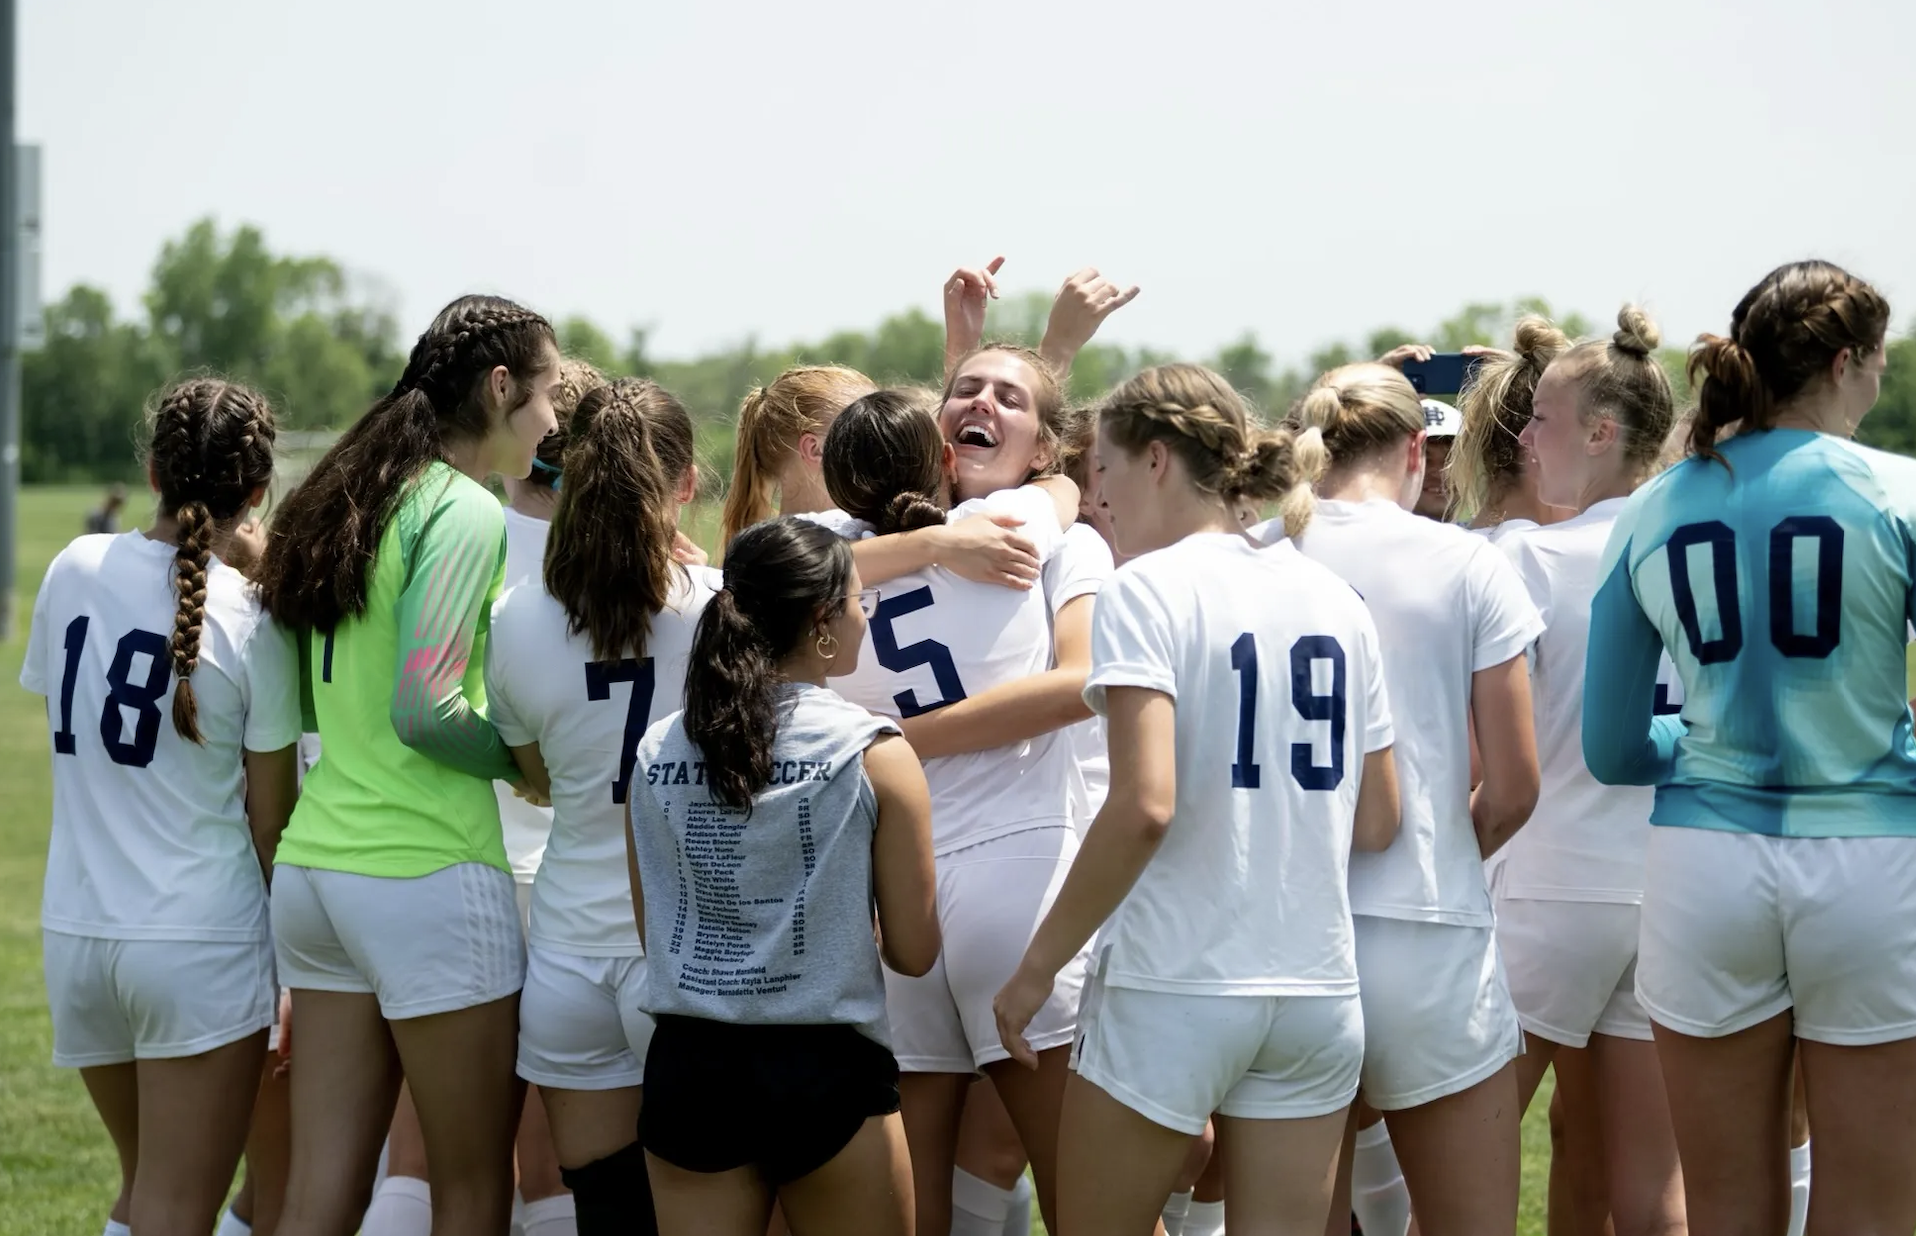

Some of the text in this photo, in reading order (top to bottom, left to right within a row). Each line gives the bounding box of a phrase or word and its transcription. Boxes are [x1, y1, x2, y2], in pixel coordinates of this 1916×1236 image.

[1667, 515, 1845, 667] 00
[868, 584, 968, 719] 5
[54, 615, 173, 769] 18
[1230, 632, 1346, 791] 19
[584, 656, 656, 804] 7
[646, 761, 833, 787] STAT CCER
[687, 816, 708, 824] Abby
[685, 830, 718, 838] Addison
[684, 845, 713, 854] Ashley
[711, 876, 736, 884] White
[709, 884, 739, 892] Gengler
[677, 905, 688, 913] 14
[698, 923, 725, 932] Natalie
[672, 933, 683, 941] 20
[670, 939, 682, 948] 22
[695, 938, 725, 948] Katelyn
[693, 945, 722, 955] Maggie
[682, 963, 710, 976] Coach:
[680, 972, 802, 987] Assistant Coach: Kayla Lanphier
[677, 981, 716, 996] Manager:
[756, 984, 787, 995] Venturi
